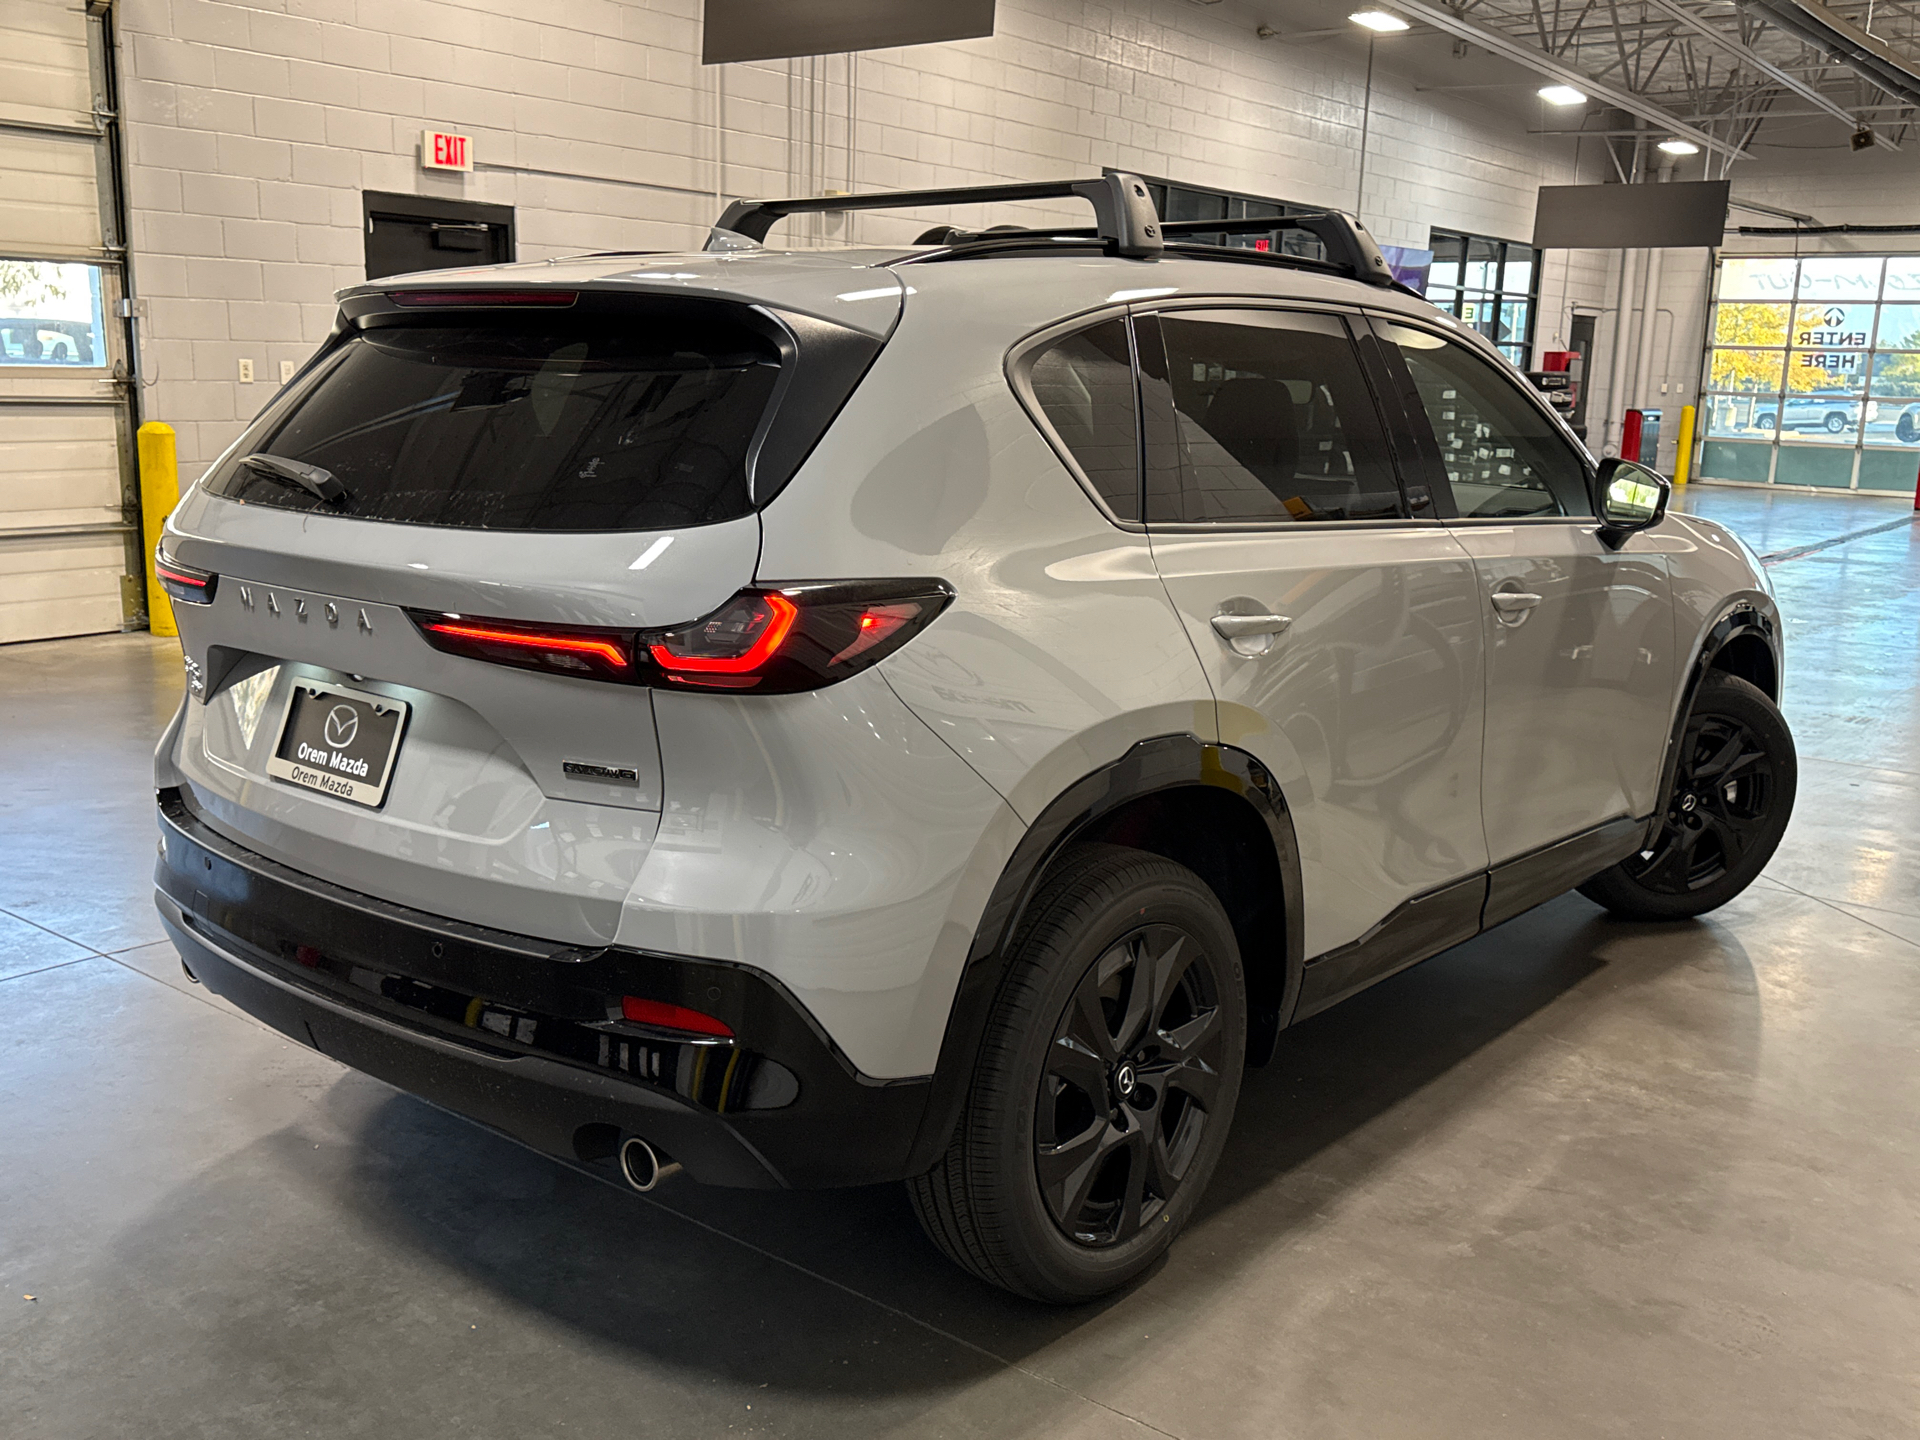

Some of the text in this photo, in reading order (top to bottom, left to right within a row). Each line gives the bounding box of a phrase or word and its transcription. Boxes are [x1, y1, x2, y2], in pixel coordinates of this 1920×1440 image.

[434, 133, 466, 168] EXIT
[240, 586, 373, 631] MAZDA
[297, 742, 369, 777] Orem Mazda
[291, 766, 353, 797] Orem Mazda
